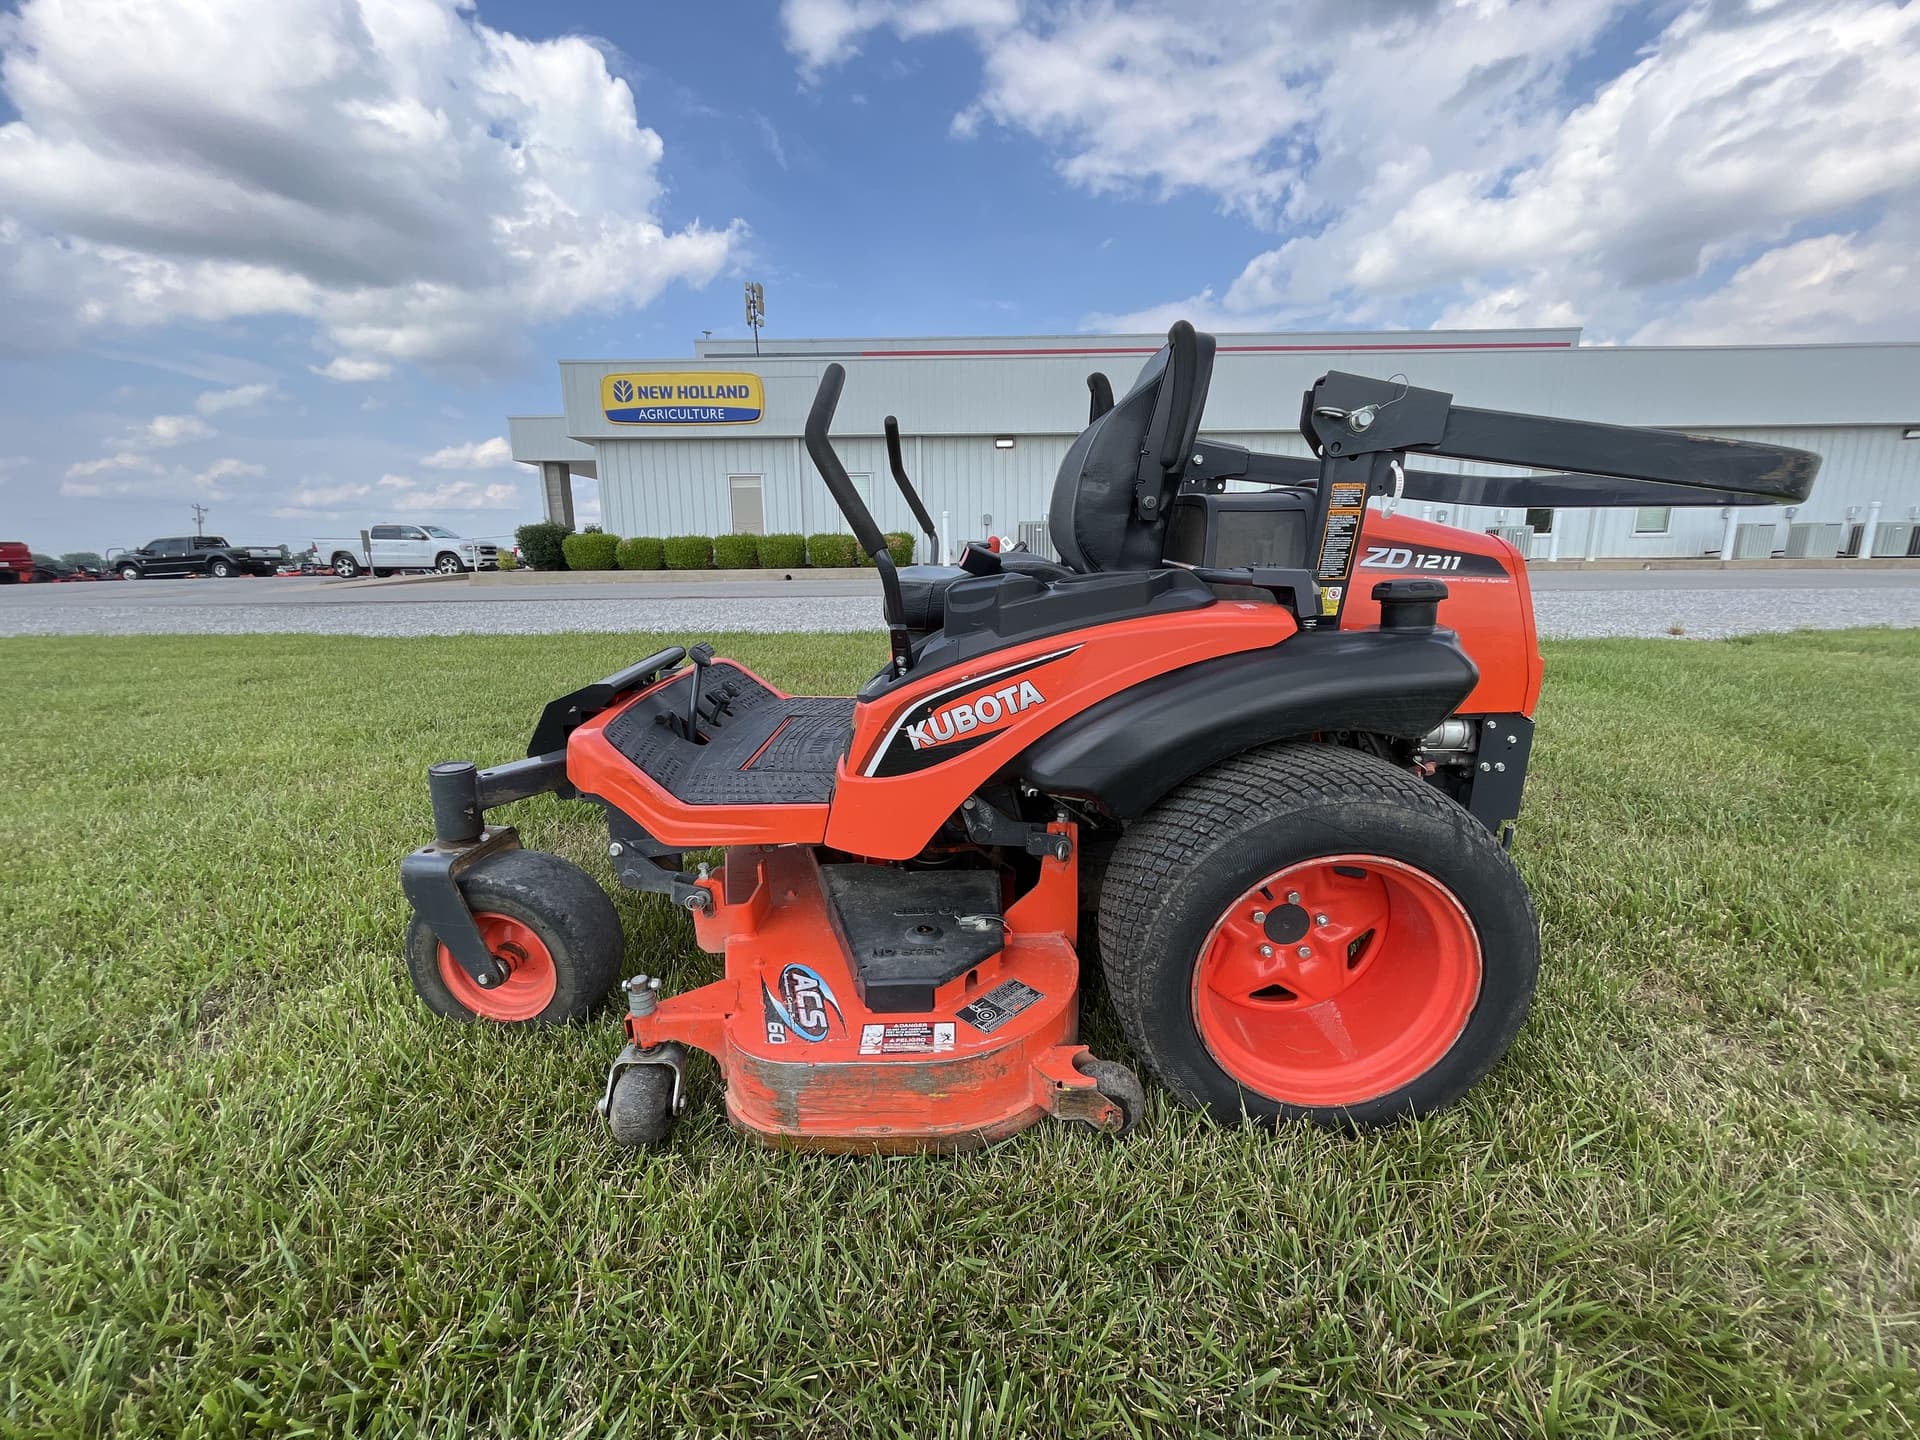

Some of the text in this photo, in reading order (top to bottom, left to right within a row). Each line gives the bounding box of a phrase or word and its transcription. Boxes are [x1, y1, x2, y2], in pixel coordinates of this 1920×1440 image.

[637, 385, 750, 400] NEW HOLLAND
[638, 408, 725, 420] AGRICULTURE
[1360, 547, 1462, 570] ZD 1211
[906, 679, 1047, 751] KUBOTA
[792, 973, 828, 1029] ACS
[767, 1022, 786, 1044] 60
